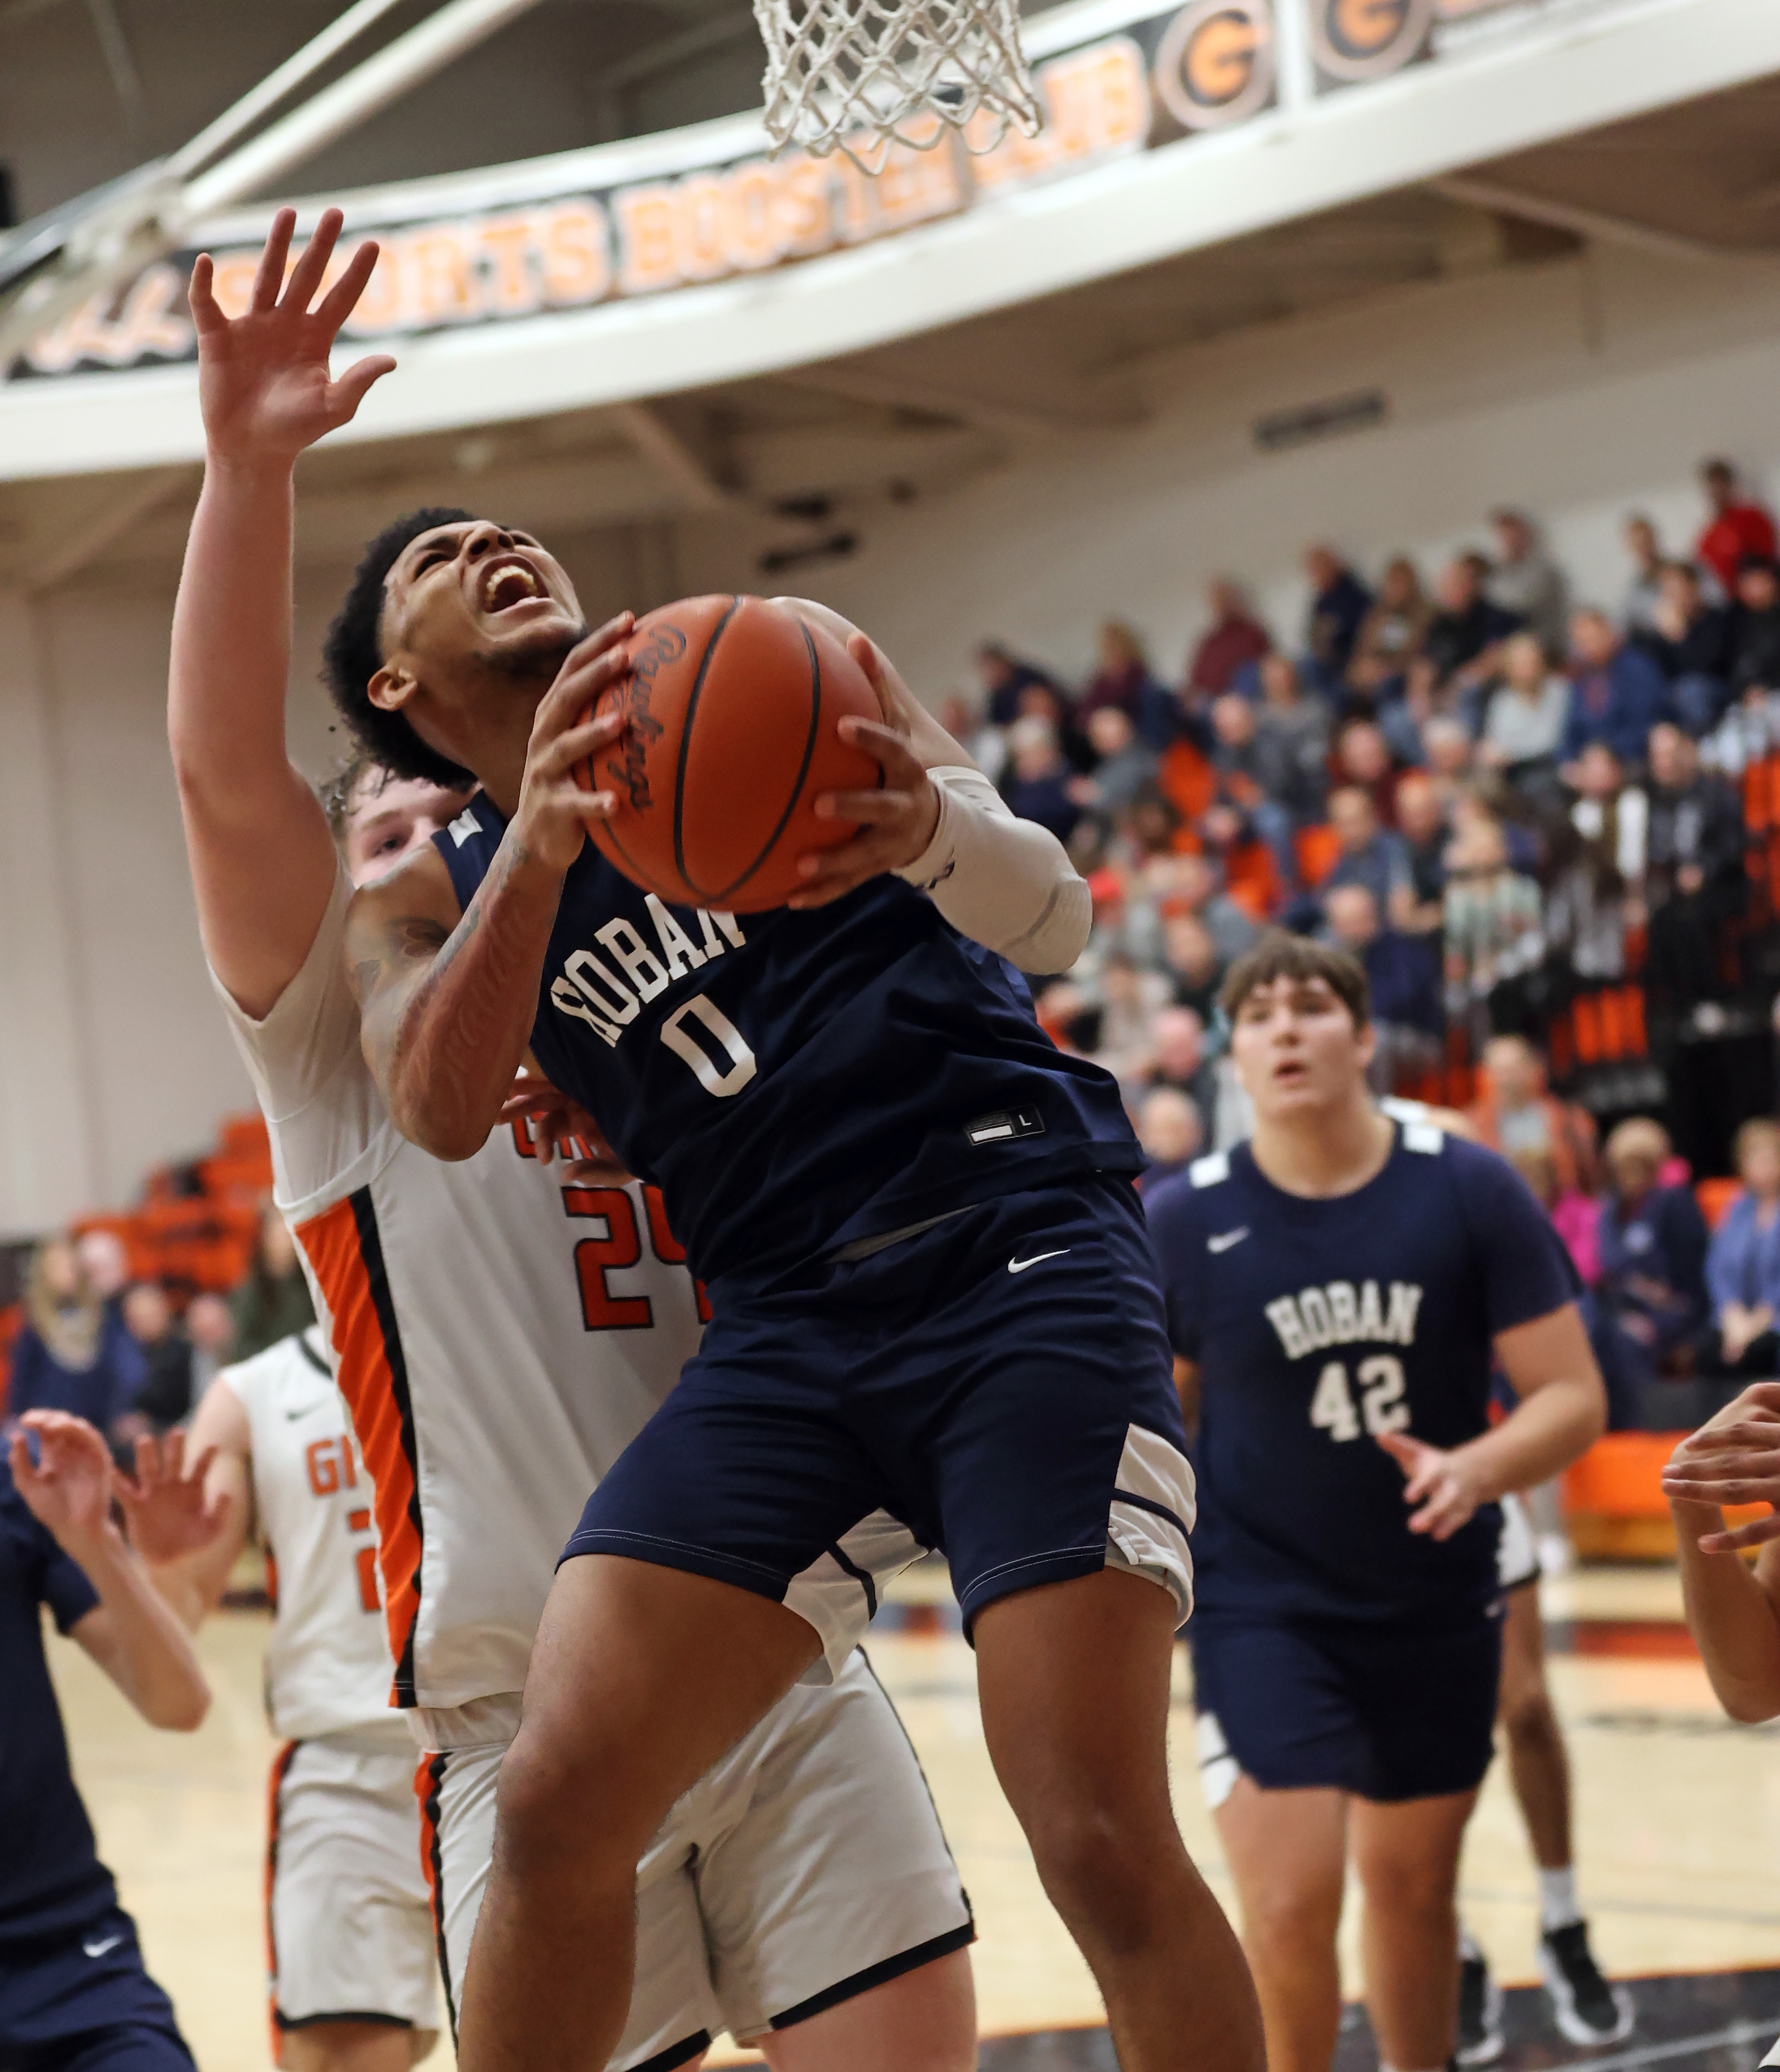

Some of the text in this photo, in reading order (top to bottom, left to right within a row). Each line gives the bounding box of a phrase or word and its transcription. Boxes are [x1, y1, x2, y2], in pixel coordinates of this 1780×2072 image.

[210, 196, 608, 337] SORTS
[549, 892, 747, 1048] HOBAN
[659, 993, 757, 1097] 0
[1018, 1114, 1032, 1126] L
[1265, 1278, 1423, 1361] HOBAN
[1310, 1355, 1411, 1442] 42
